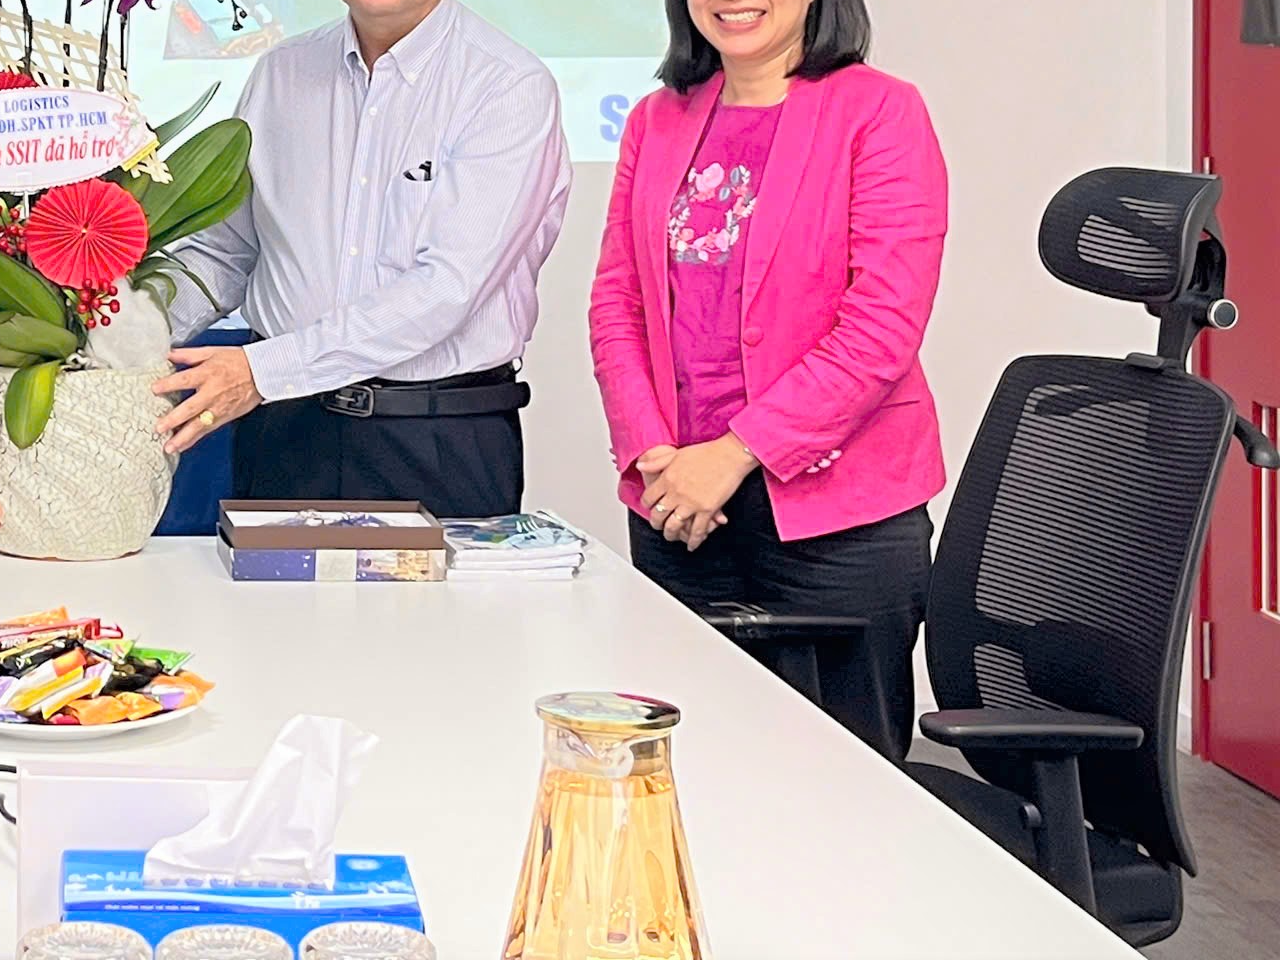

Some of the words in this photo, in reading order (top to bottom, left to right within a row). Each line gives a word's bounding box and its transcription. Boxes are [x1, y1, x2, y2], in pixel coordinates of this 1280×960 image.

[4, 96, 69, 114] LOGISTICS
[58, 111, 108, 129] TP.HCM
[6, 139, 41, 166] SSIT
